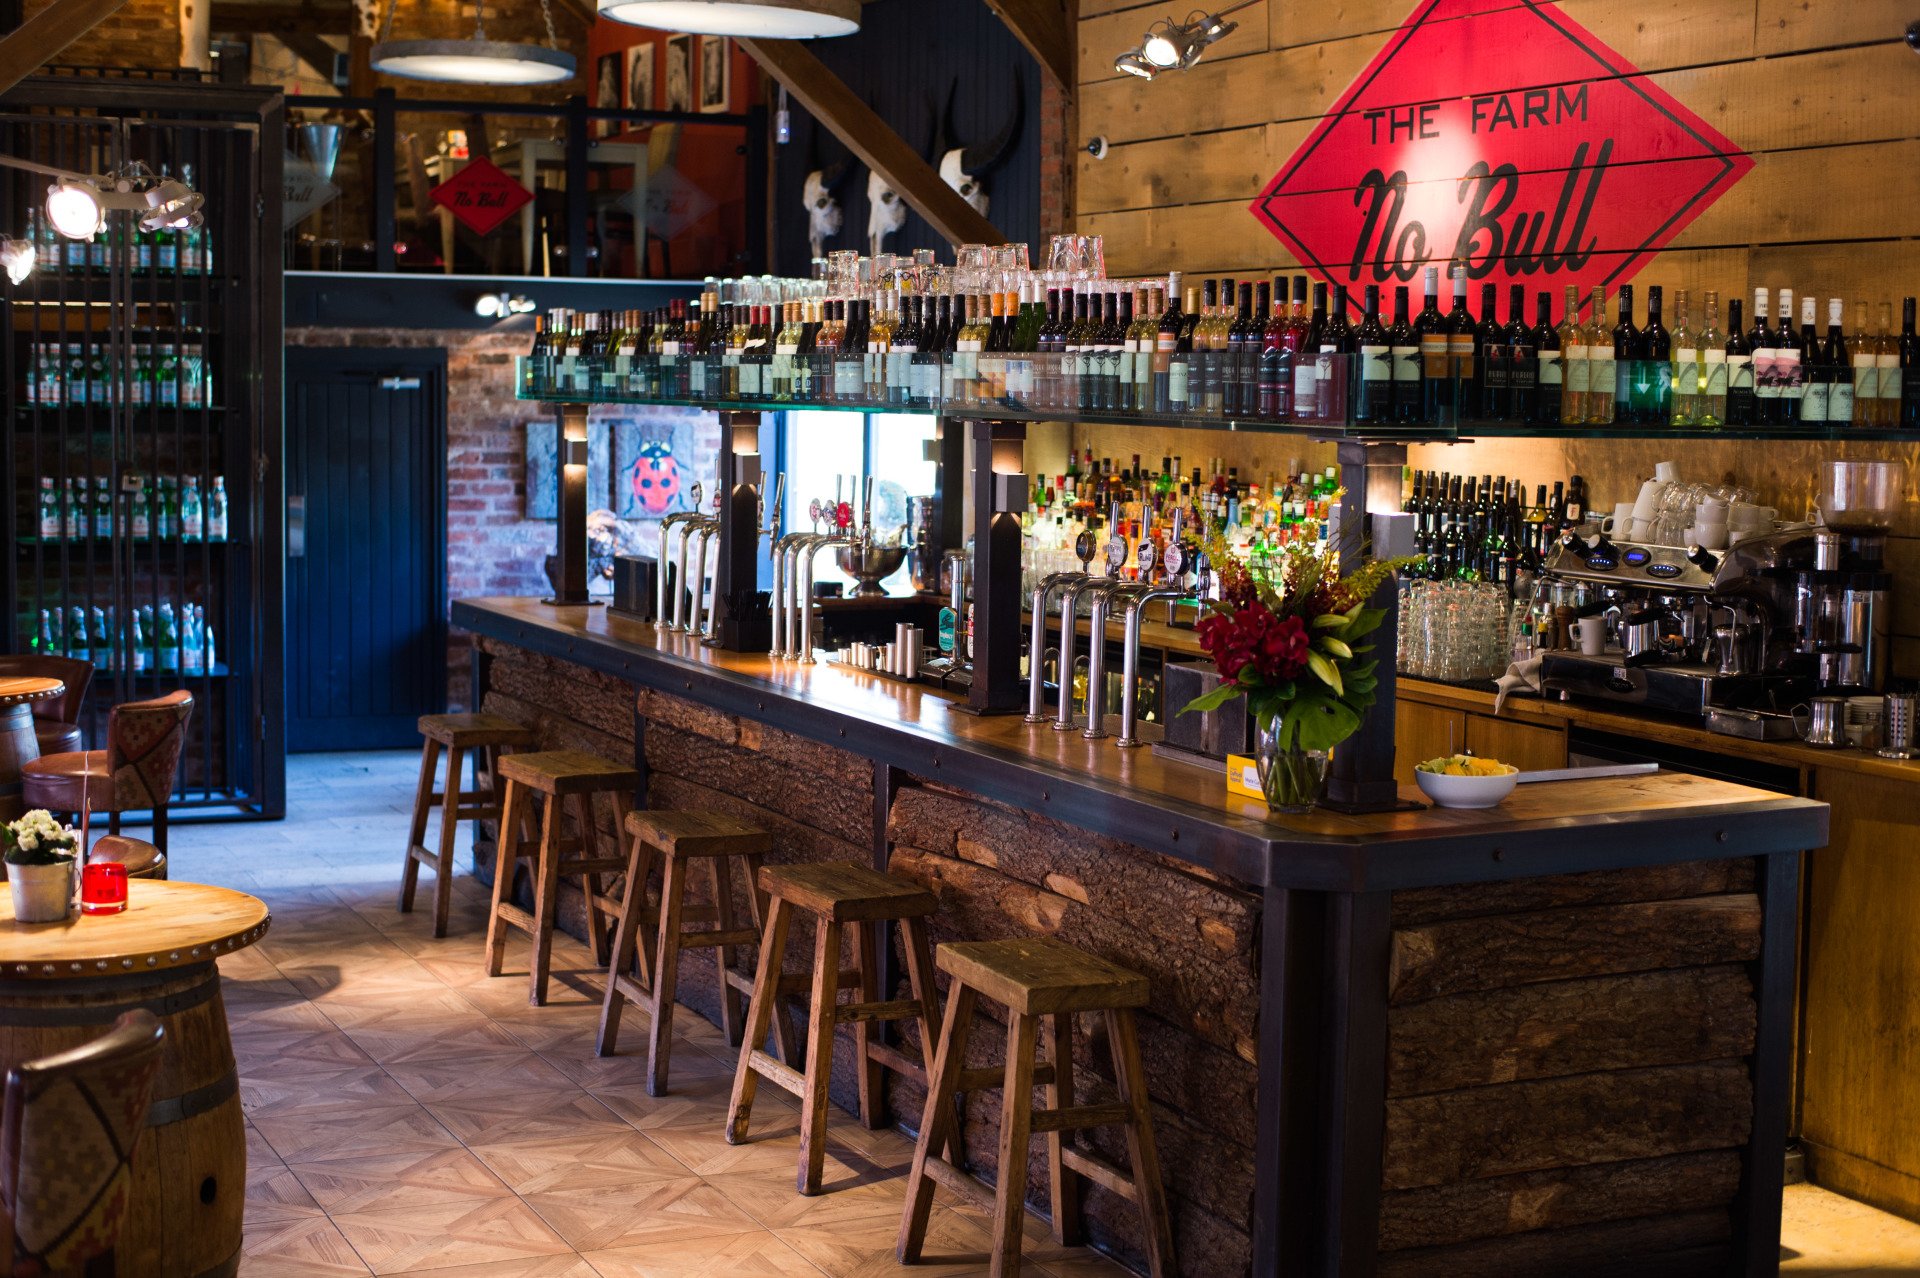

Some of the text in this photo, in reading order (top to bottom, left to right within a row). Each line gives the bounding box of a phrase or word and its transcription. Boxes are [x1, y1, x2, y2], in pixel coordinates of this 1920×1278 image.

[1363, 84, 1589, 145] THE FARM
[454, 191, 509, 207] No Bull
[1348, 138, 1615, 282] No Bull
